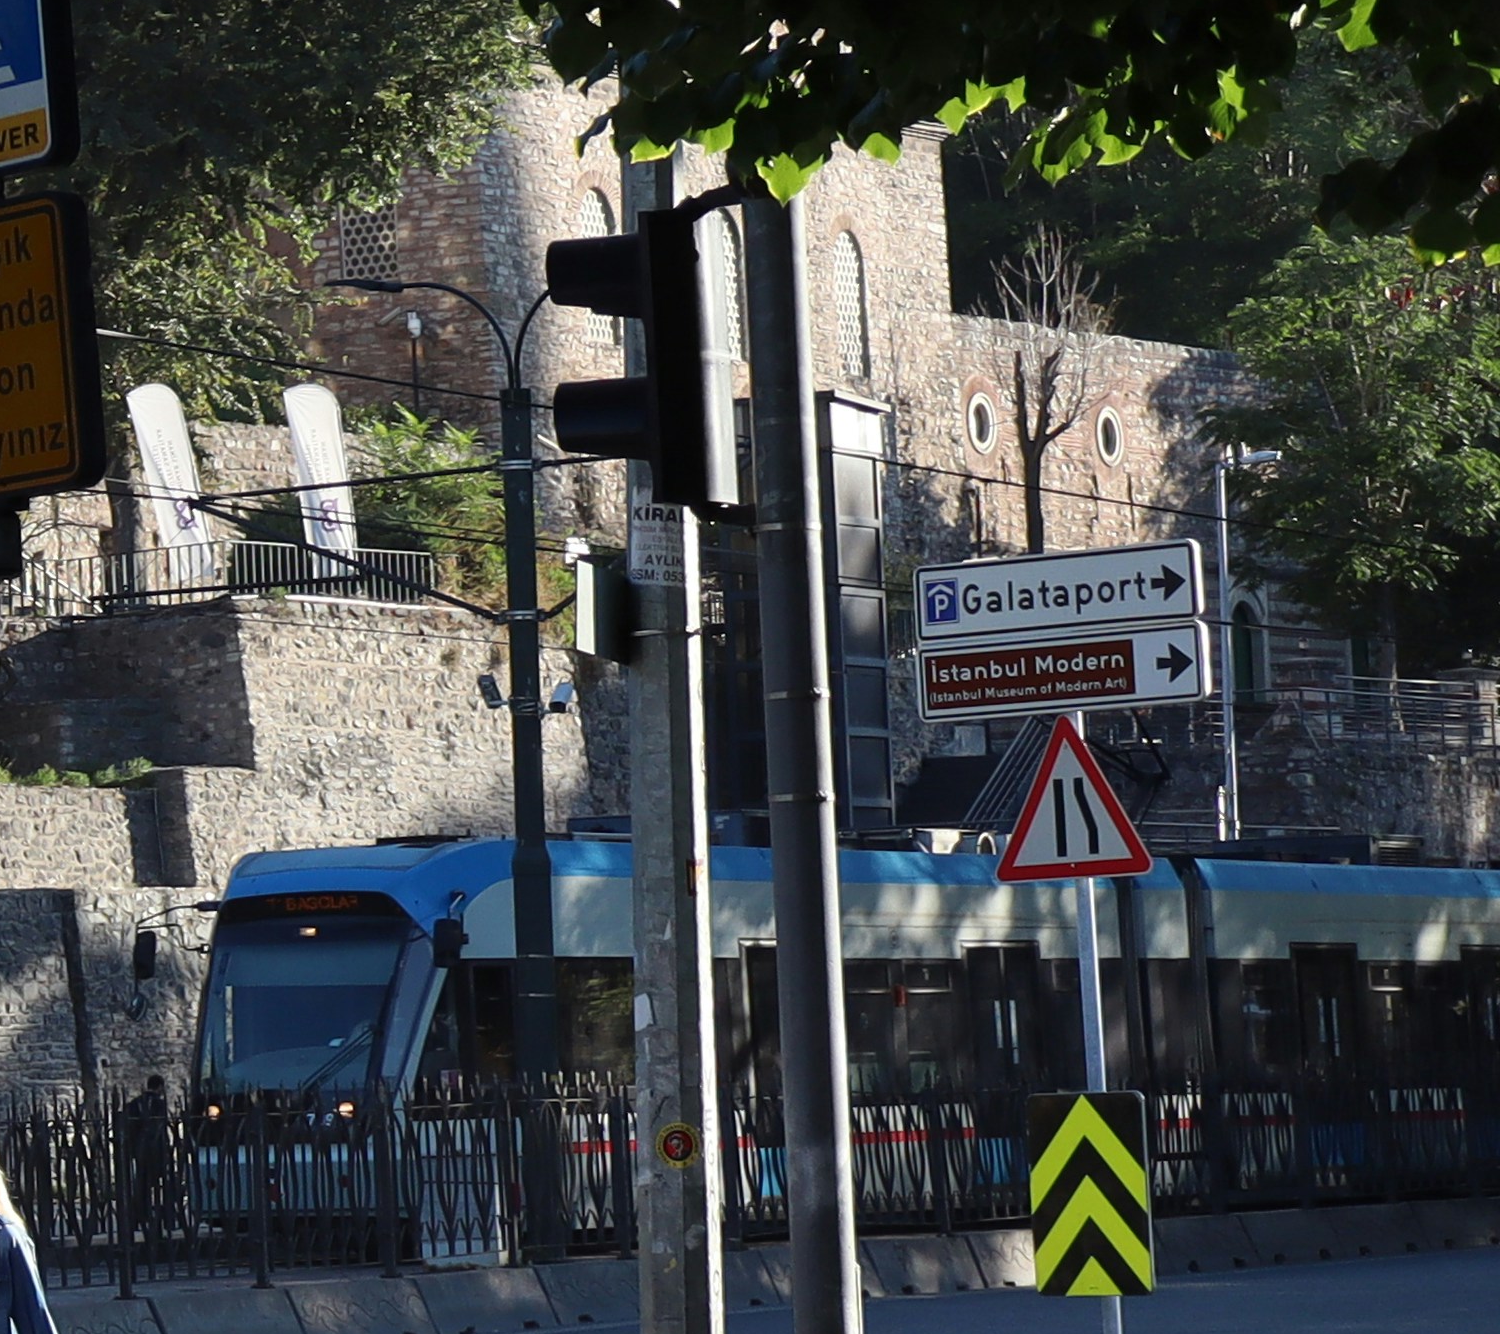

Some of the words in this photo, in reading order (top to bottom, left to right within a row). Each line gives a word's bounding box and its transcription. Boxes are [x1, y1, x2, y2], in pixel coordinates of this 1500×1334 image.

[632, 503, 684, 524] KİRA
[962, 571, 1147, 615] Galataport
[930, 656, 1026, 684] İstanbul
[1035, 651, 1125, 675] Modern
[984, 685, 1037, 699] Museum
[1040, 681, 1052, 695] of
[1054, 679, 1102, 694] Modern
[1104, 676, 1128, 690] Art)
